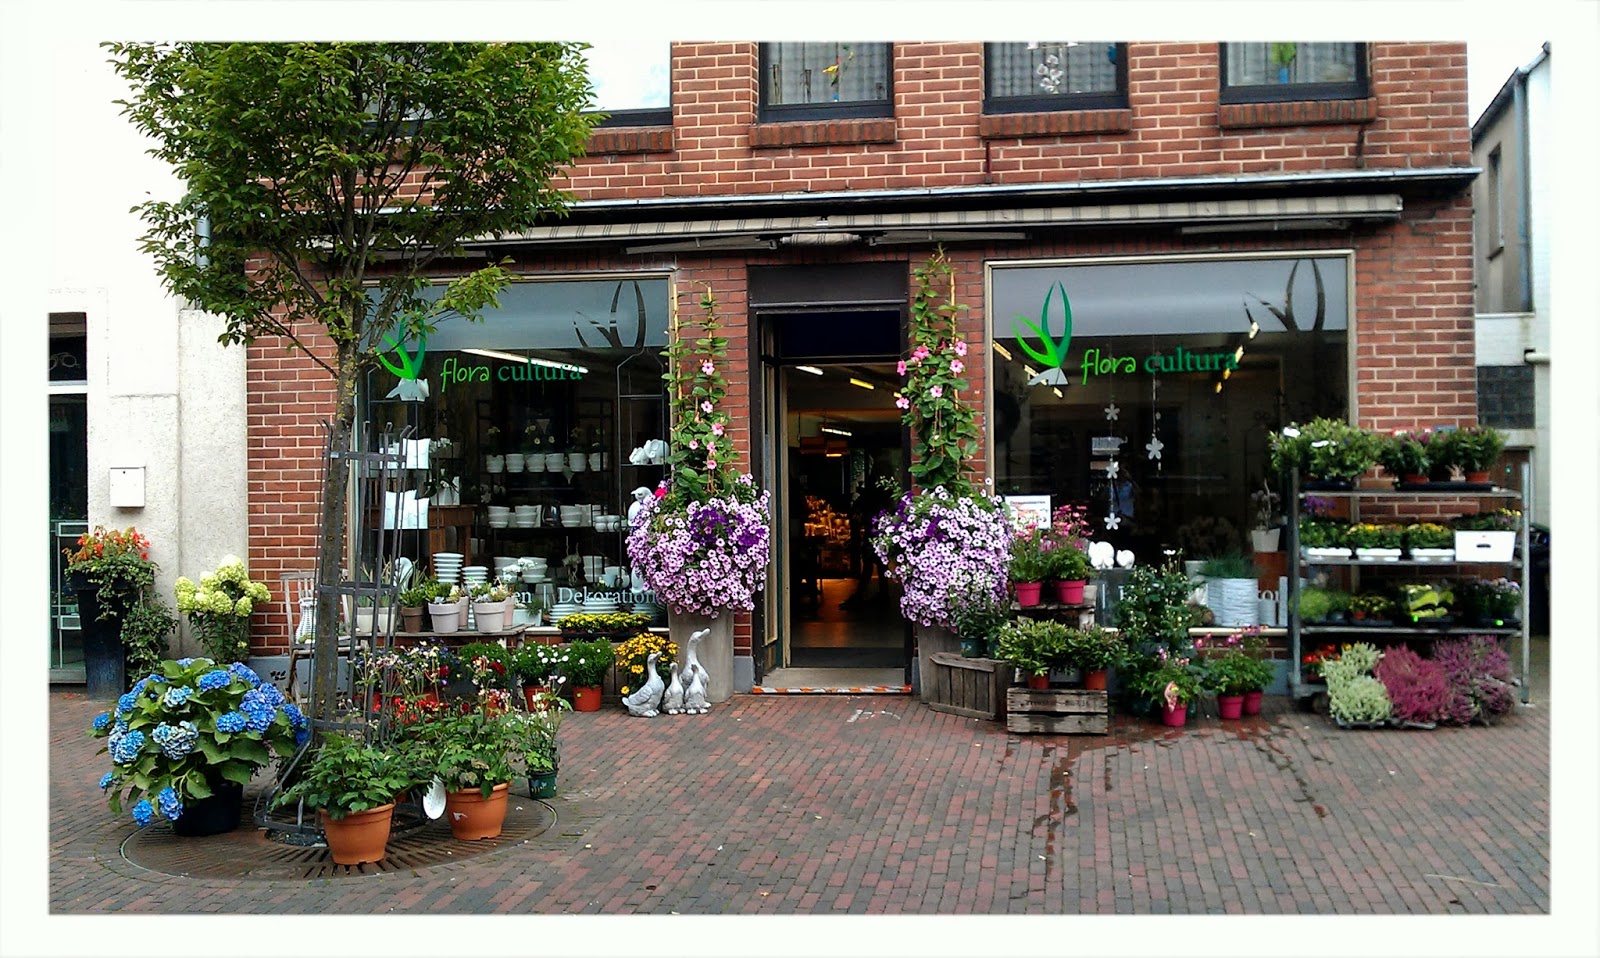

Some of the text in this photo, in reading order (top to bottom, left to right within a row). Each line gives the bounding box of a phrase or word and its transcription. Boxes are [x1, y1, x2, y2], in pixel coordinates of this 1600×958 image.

[441, 358, 582, 392] flora cultura
[1081, 347, 1240, 386] flora cultura
[558, 587, 656, 605] Dekoration
